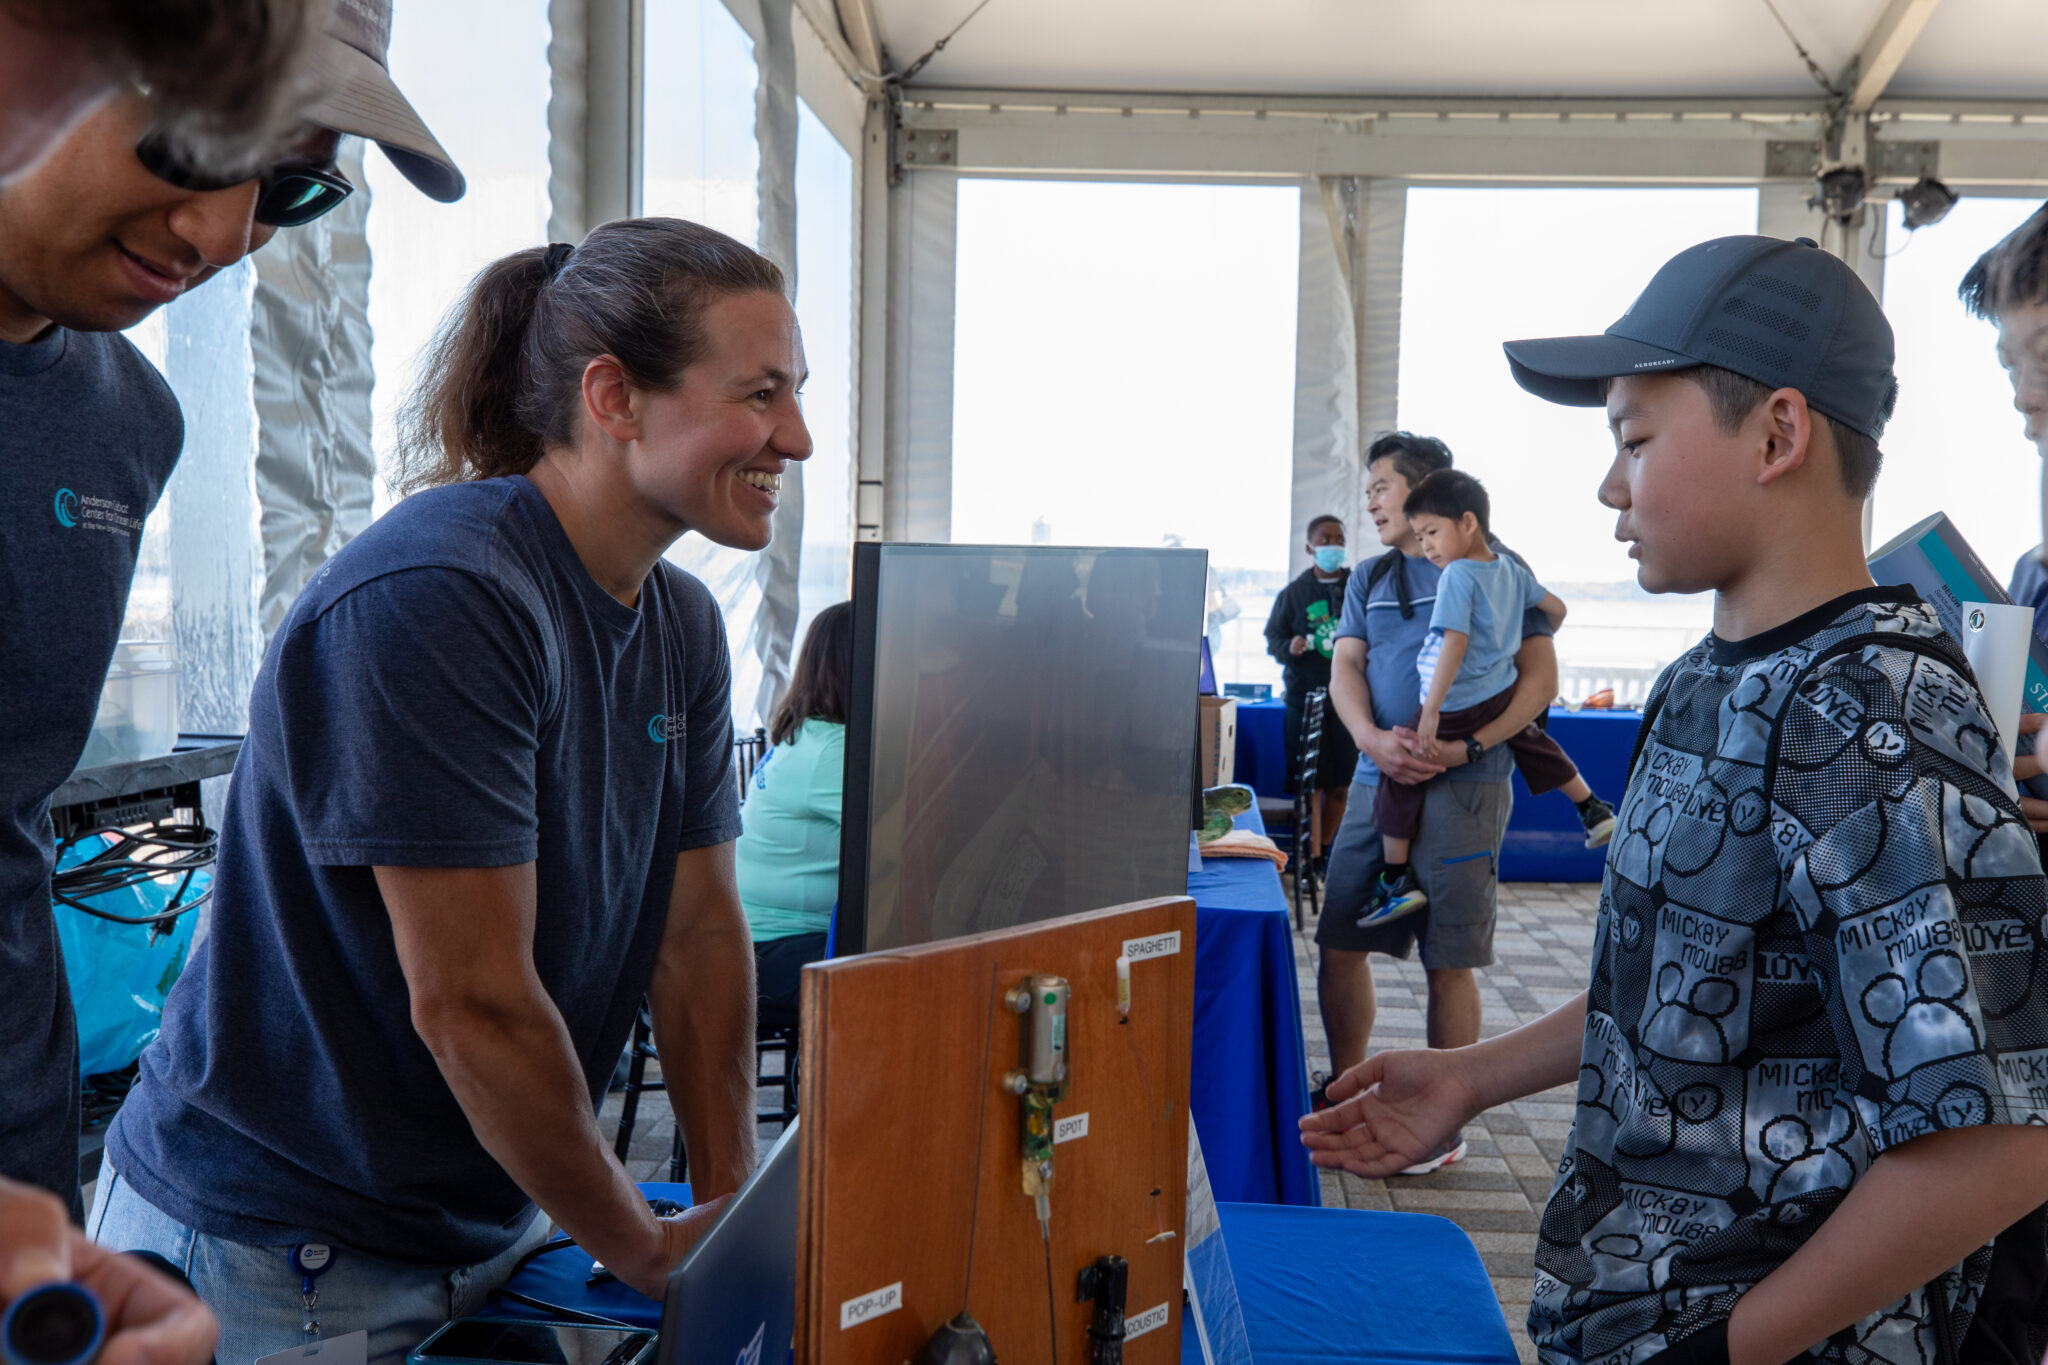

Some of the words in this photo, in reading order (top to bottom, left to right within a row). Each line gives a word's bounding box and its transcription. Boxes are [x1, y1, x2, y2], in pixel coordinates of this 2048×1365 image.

[1127, 936, 1176, 957] SPAGHETTI
[1058, 1118, 1083, 1137] SPOT
[847, 1289, 897, 1320] POP-UP
[1126, 1308, 1166, 1335] COUSTIC
